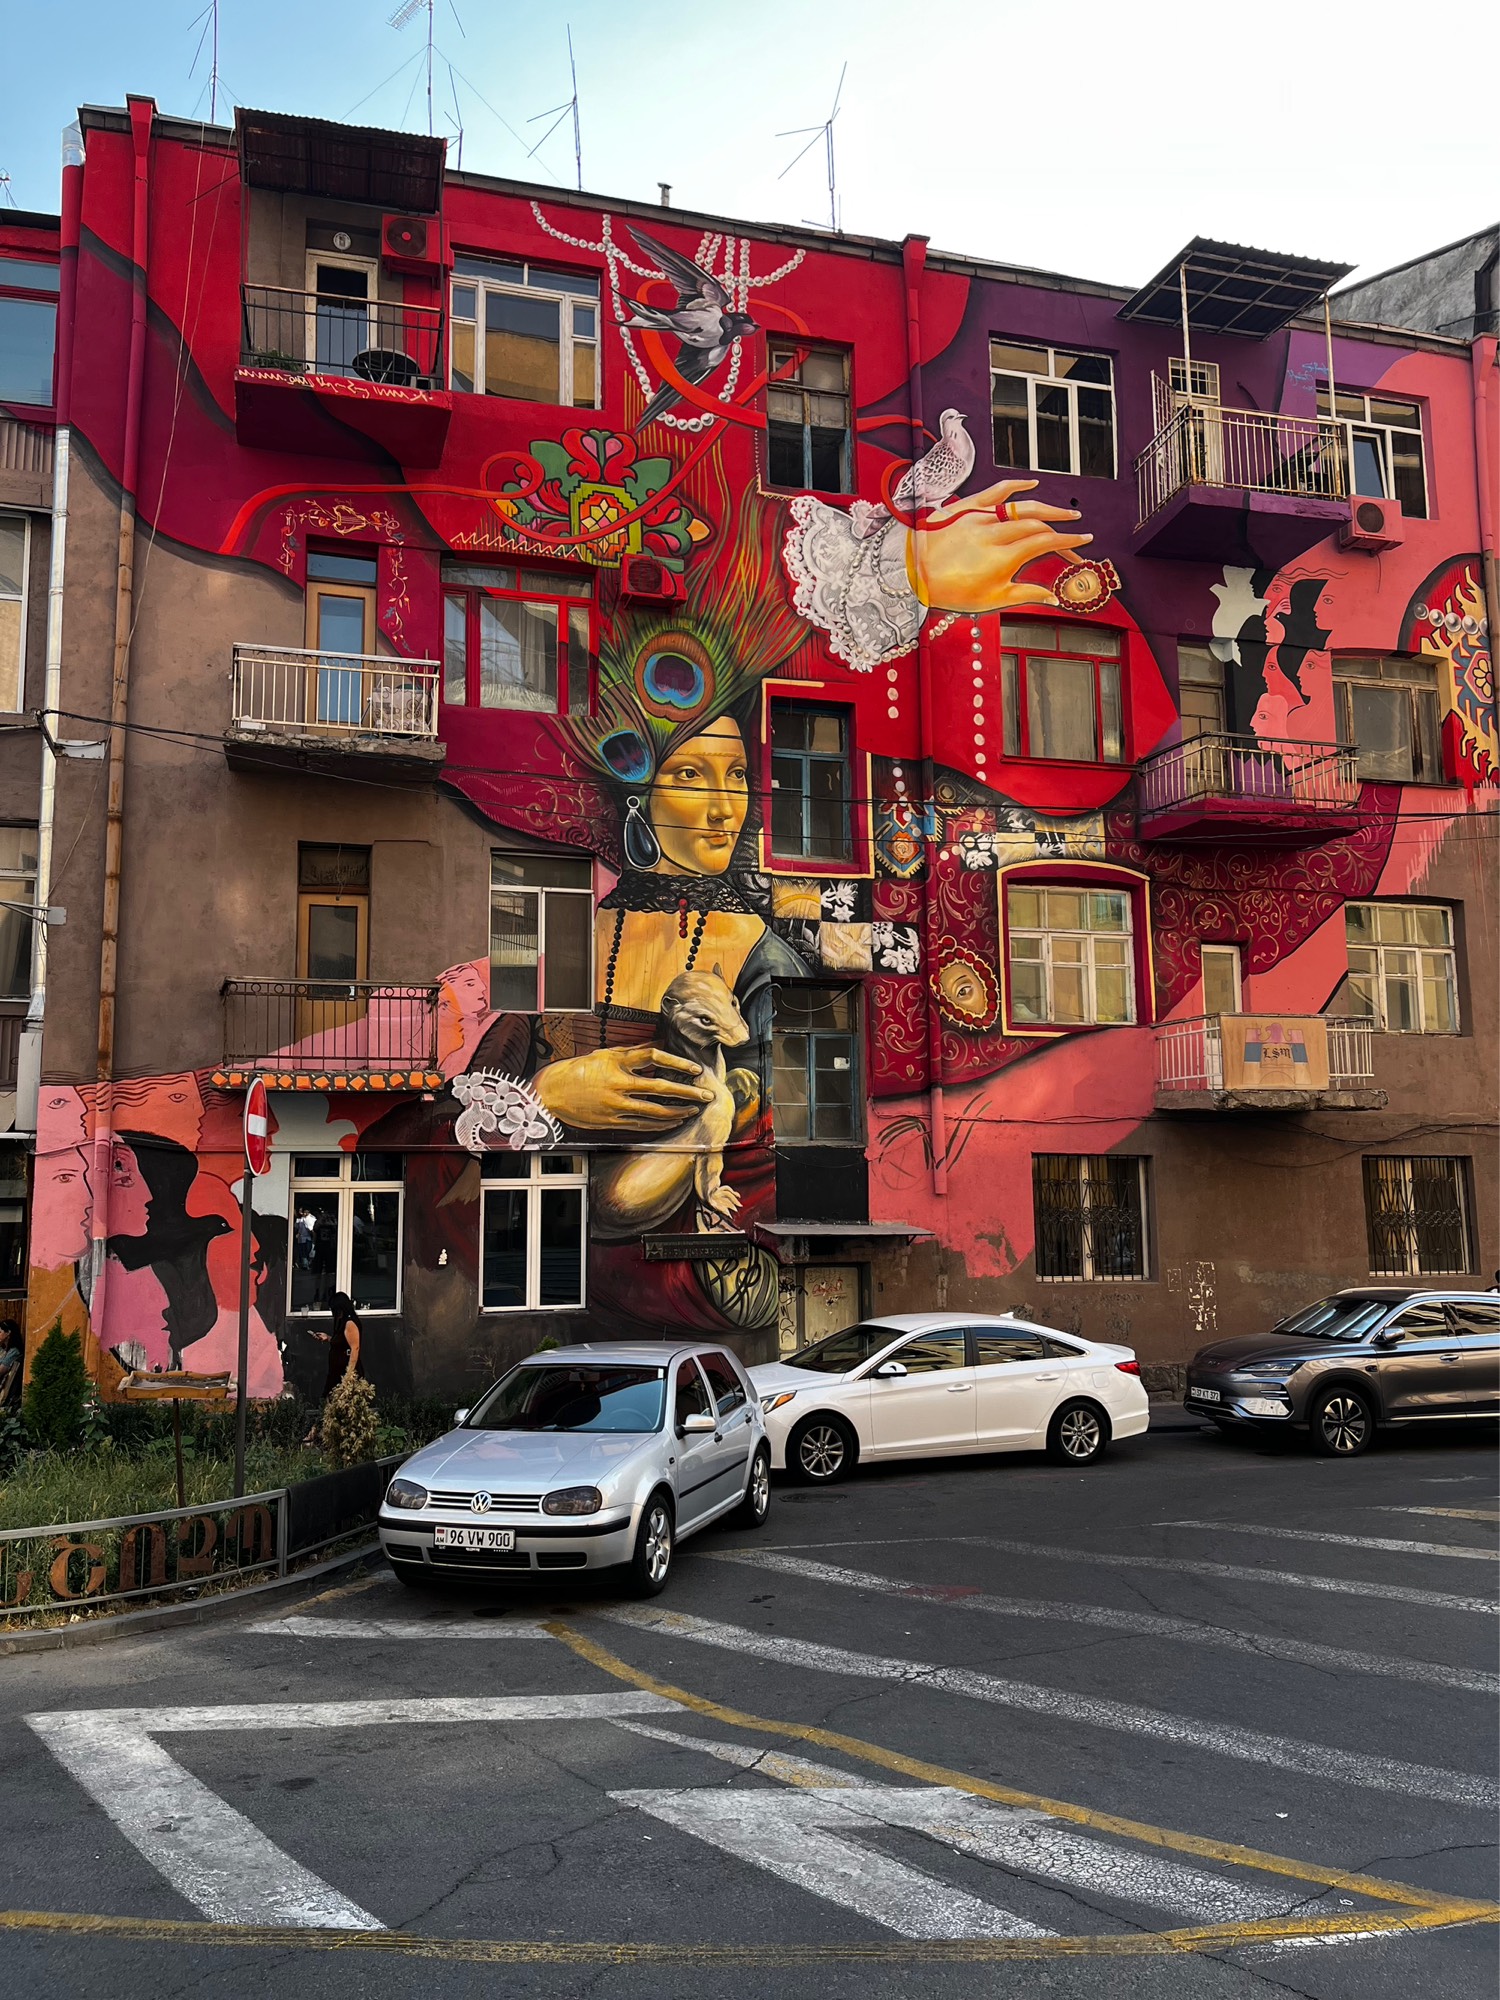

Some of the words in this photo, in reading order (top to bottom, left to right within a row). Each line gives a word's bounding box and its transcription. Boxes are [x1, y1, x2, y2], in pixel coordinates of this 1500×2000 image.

[450, 1530, 464, 1545] 96
[468, 1531, 485, 1546] VW
[488, 1532, 510, 1547] 900
